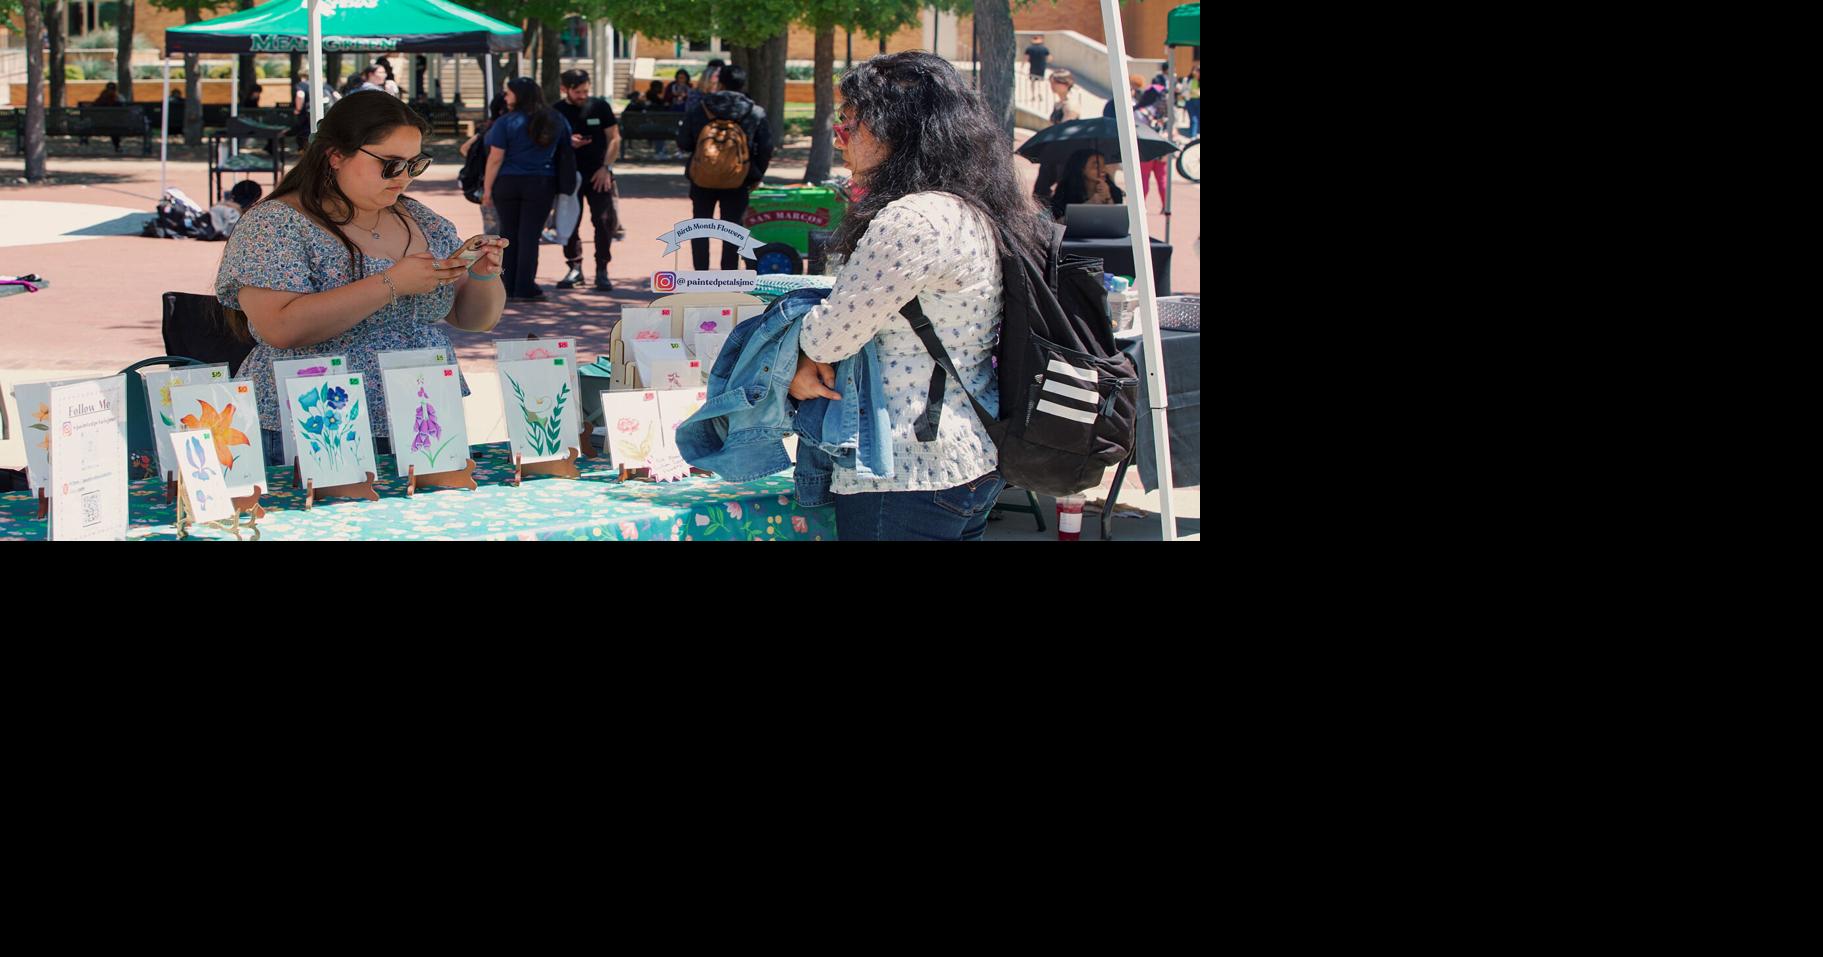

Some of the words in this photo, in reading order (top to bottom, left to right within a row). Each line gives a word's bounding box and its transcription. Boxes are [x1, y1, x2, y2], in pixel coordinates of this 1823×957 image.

[322, 36, 401, 51] GREEN
[749, 213, 771, 224] SAN
[776, 212, 823, 225] MARCOS
[677, 226, 693, 237] Birth
[693, 222, 716, 230] Month
[717, 224, 744, 240] Flowers
[677, 278, 686, 286] @
[687, 278, 754, 288] paintedpetalsjmc
[68, 403, 95, 417] Follow
[98, 399, 111, 410] Me
